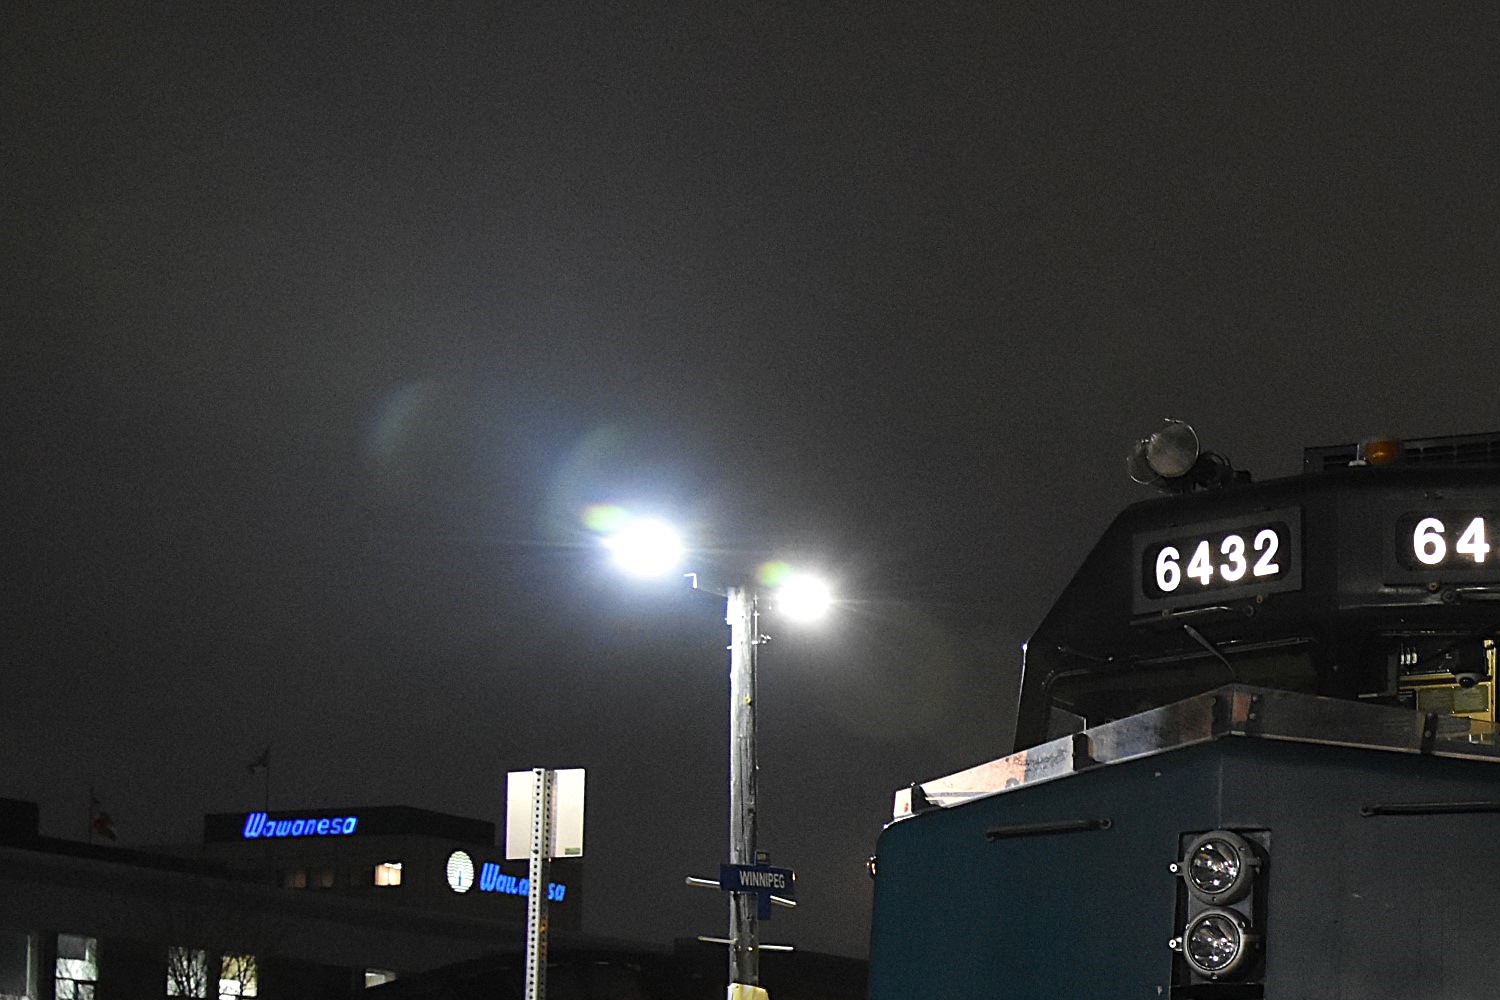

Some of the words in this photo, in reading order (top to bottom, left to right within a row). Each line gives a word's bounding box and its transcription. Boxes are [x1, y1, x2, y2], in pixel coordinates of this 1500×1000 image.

[1155, 528, 1280, 593] 6432
[243, 811, 358, 839] Wawanesa
[480, 862, 566, 902] Wawasa
[739, 870, 786, 889] WINNIPEG
